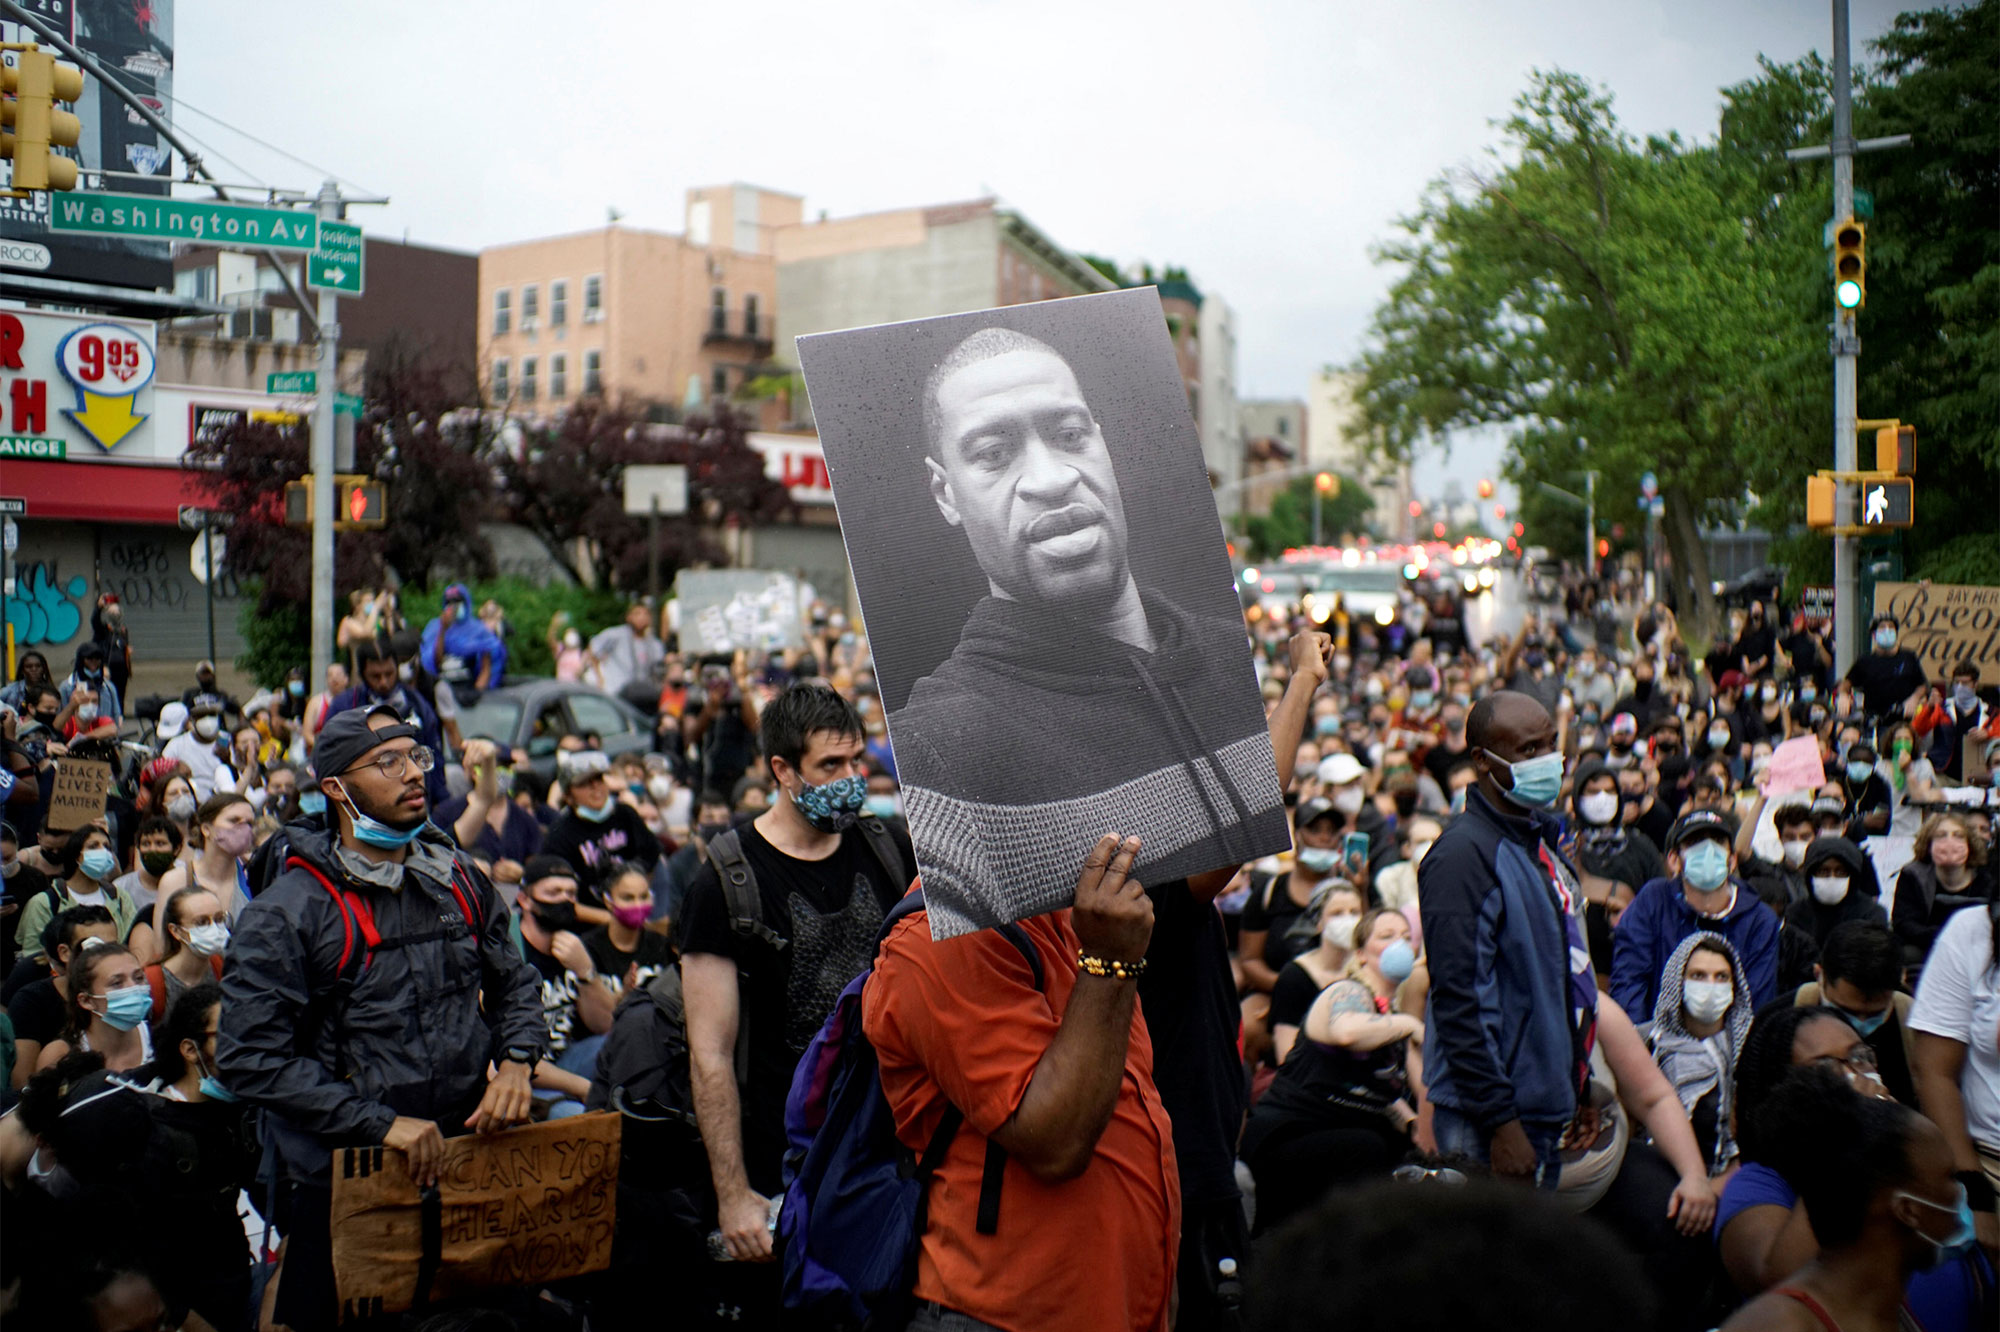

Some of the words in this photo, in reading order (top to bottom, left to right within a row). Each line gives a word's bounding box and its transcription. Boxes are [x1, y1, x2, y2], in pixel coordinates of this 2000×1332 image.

[62, 200, 259, 238] Washington
[270, 218, 307, 241] Av
[0, 245, 43, 263] ROCK
[0, 438, 60, 454] ANGE
[1889, 585, 2000, 629] Breo
[58, 778, 102, 793] LIVES
[60, 764, 104, 780] BLACK
[54, 794, 101, 809] MATTER
[445, 1145, 543, 1192] CAN
[448, 1186, 565, 1244] HEAR
[490, 1219, 611, 1282] NOW?
